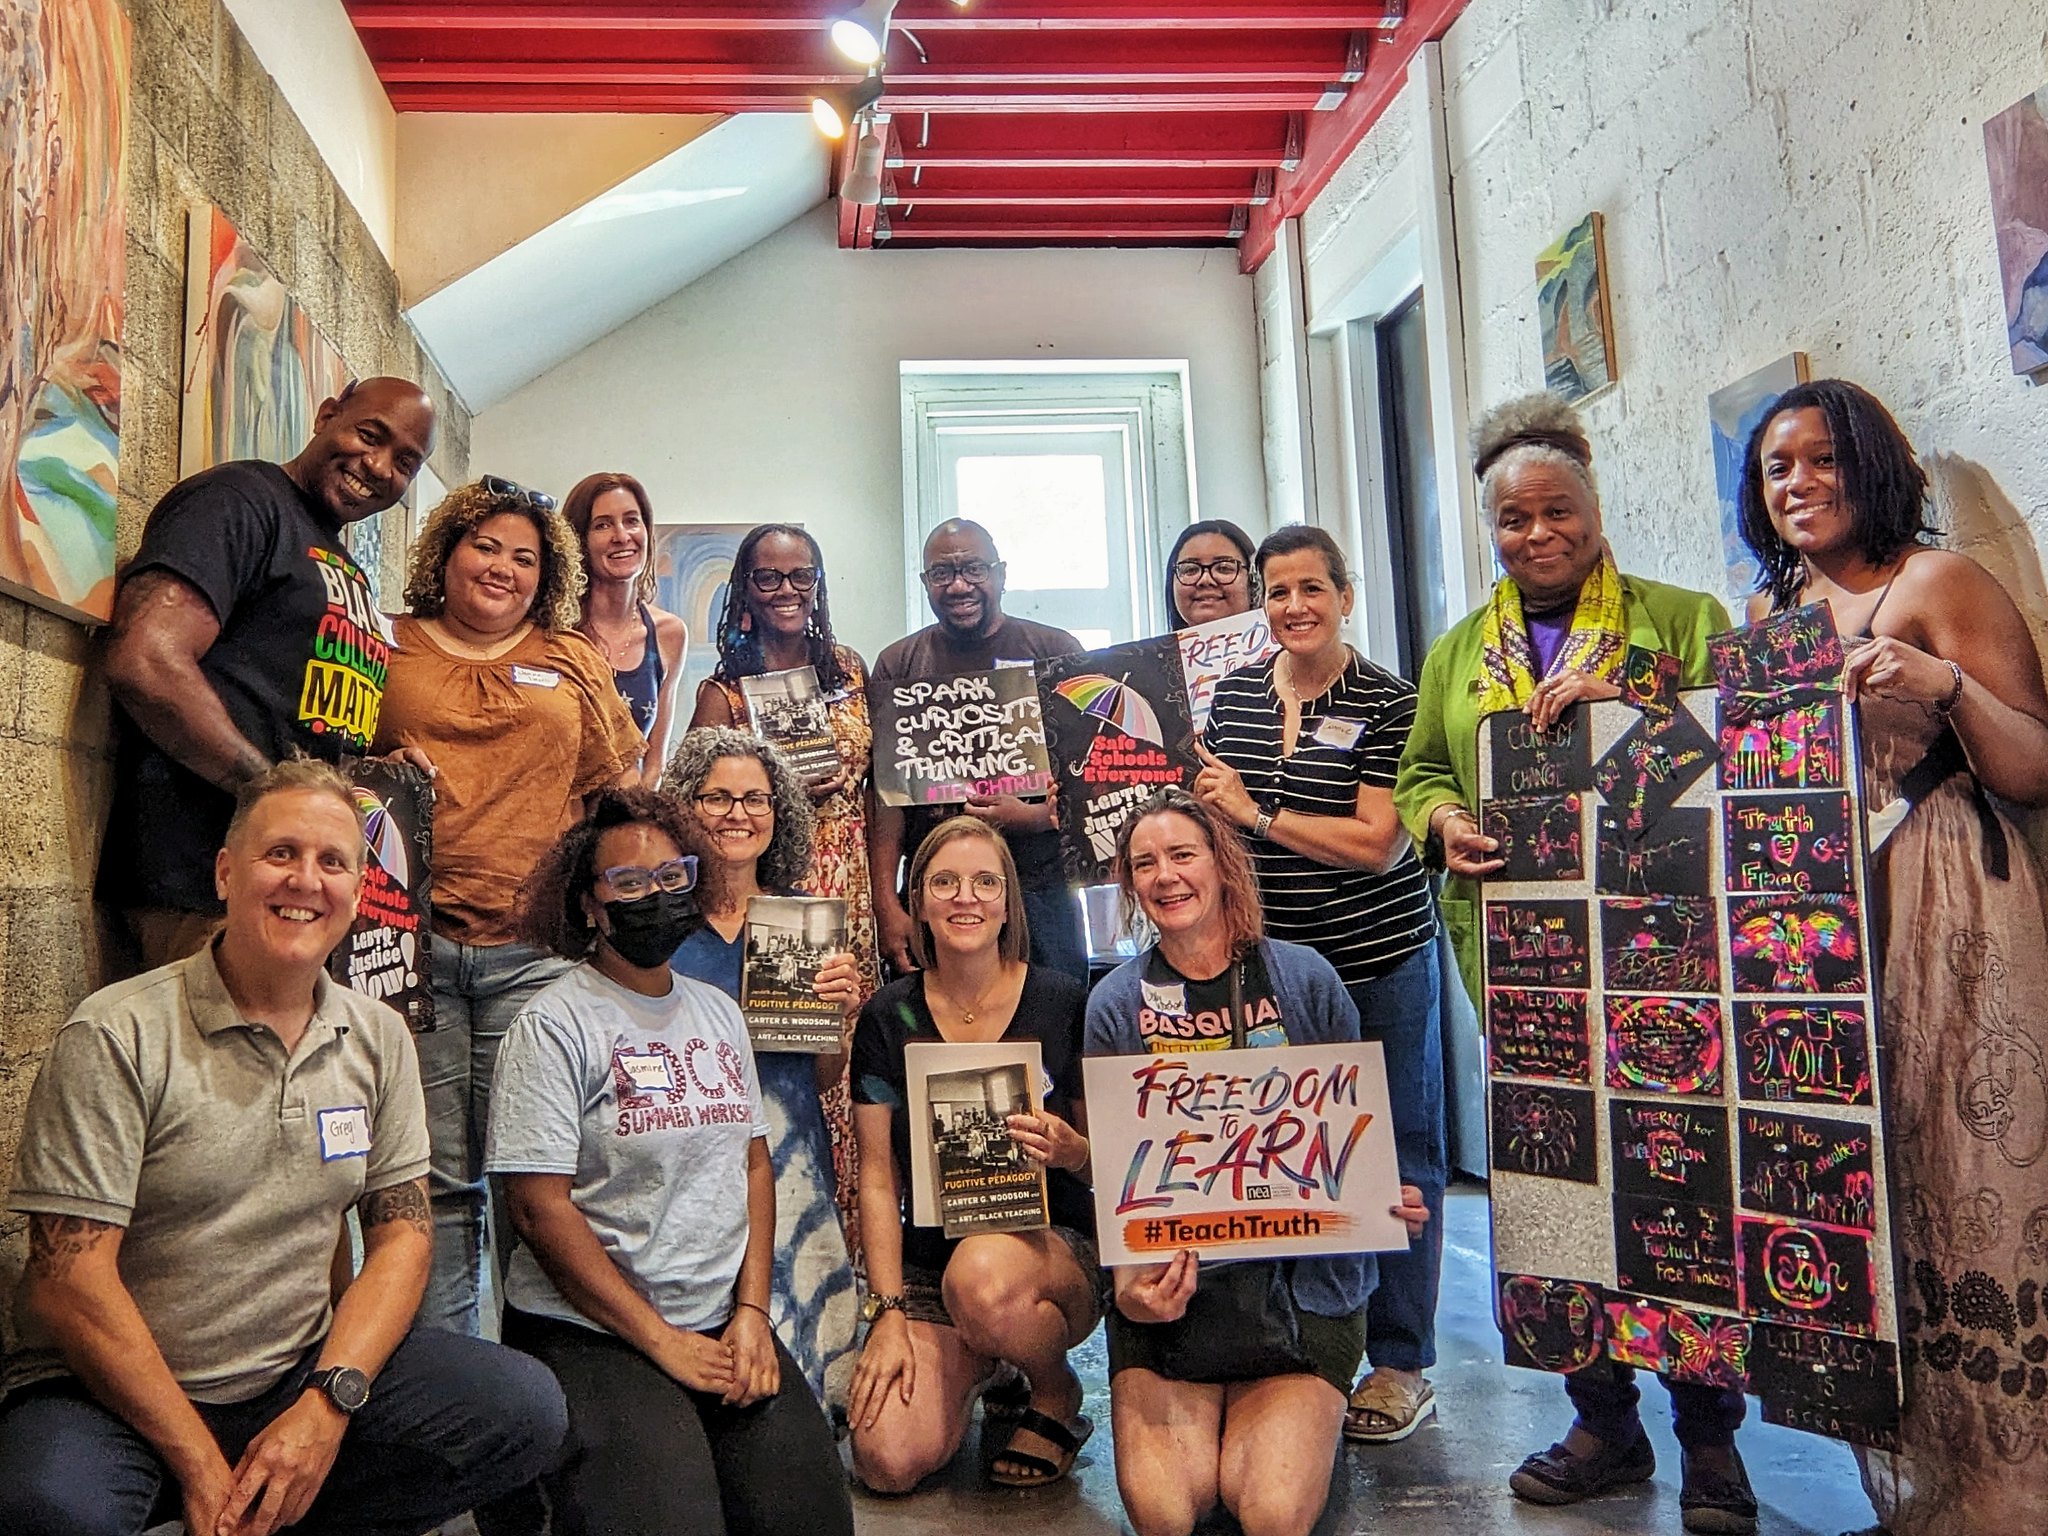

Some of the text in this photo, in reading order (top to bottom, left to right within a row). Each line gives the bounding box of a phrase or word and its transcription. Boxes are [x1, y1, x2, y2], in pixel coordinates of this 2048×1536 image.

[893, 676, 996, 707] SPARK
[895, 696, 1042, 735] CURIOSITY
[895, 722, 1046, 758] & CRITICAL
[1094, 734, 1137, 751] Safe
[894, 749, 1036, 781] THINKING.
[1089, 750, 1168, 767] Schools
[926, 772, 1052, 802] #TEACHTRUT
[1084, 766, 1184, 786] Everyone!
[1086, 783, 1158, 814] LGBTQ+
[1737, 803, 1814, 833] Truth
[357, 901, 420, 932] veryone!
[352, 926, 399, 951] LGBTQ+
[348, 945, 402, 976] Justice
[749, 999, 840, 1010] FUGITIVE PEDAGOGY
[748, 1016, 780, 1024] CARTER
[791, 1017, 830, 1026] WOODSON
[777, 1033, 802, 1041] BLACK
[1132, 1058, 1360, 1122] FREEDOM
[330, 1120, 355, 1144] Greg
[615, 1104, 694, 1137] SUMMER
[1115, 1109, 1374, 1216] LEARN
[944, 1177, 986, 1190] FUGITIVE
[988, 1172, 1037, 1186] PEDAGOGY
[1248, 1186, 1271, 1199] nea
[947, 1196, 979, 1207] CARTER
[989, 1191, 1030, 1202] WOODSON
[979, 1212, 1004, 1221] BLACK
[1004, 1208, 1042, 1218] TEACHING
[1144, 1211, 1321, 1243] #TeachTruth
